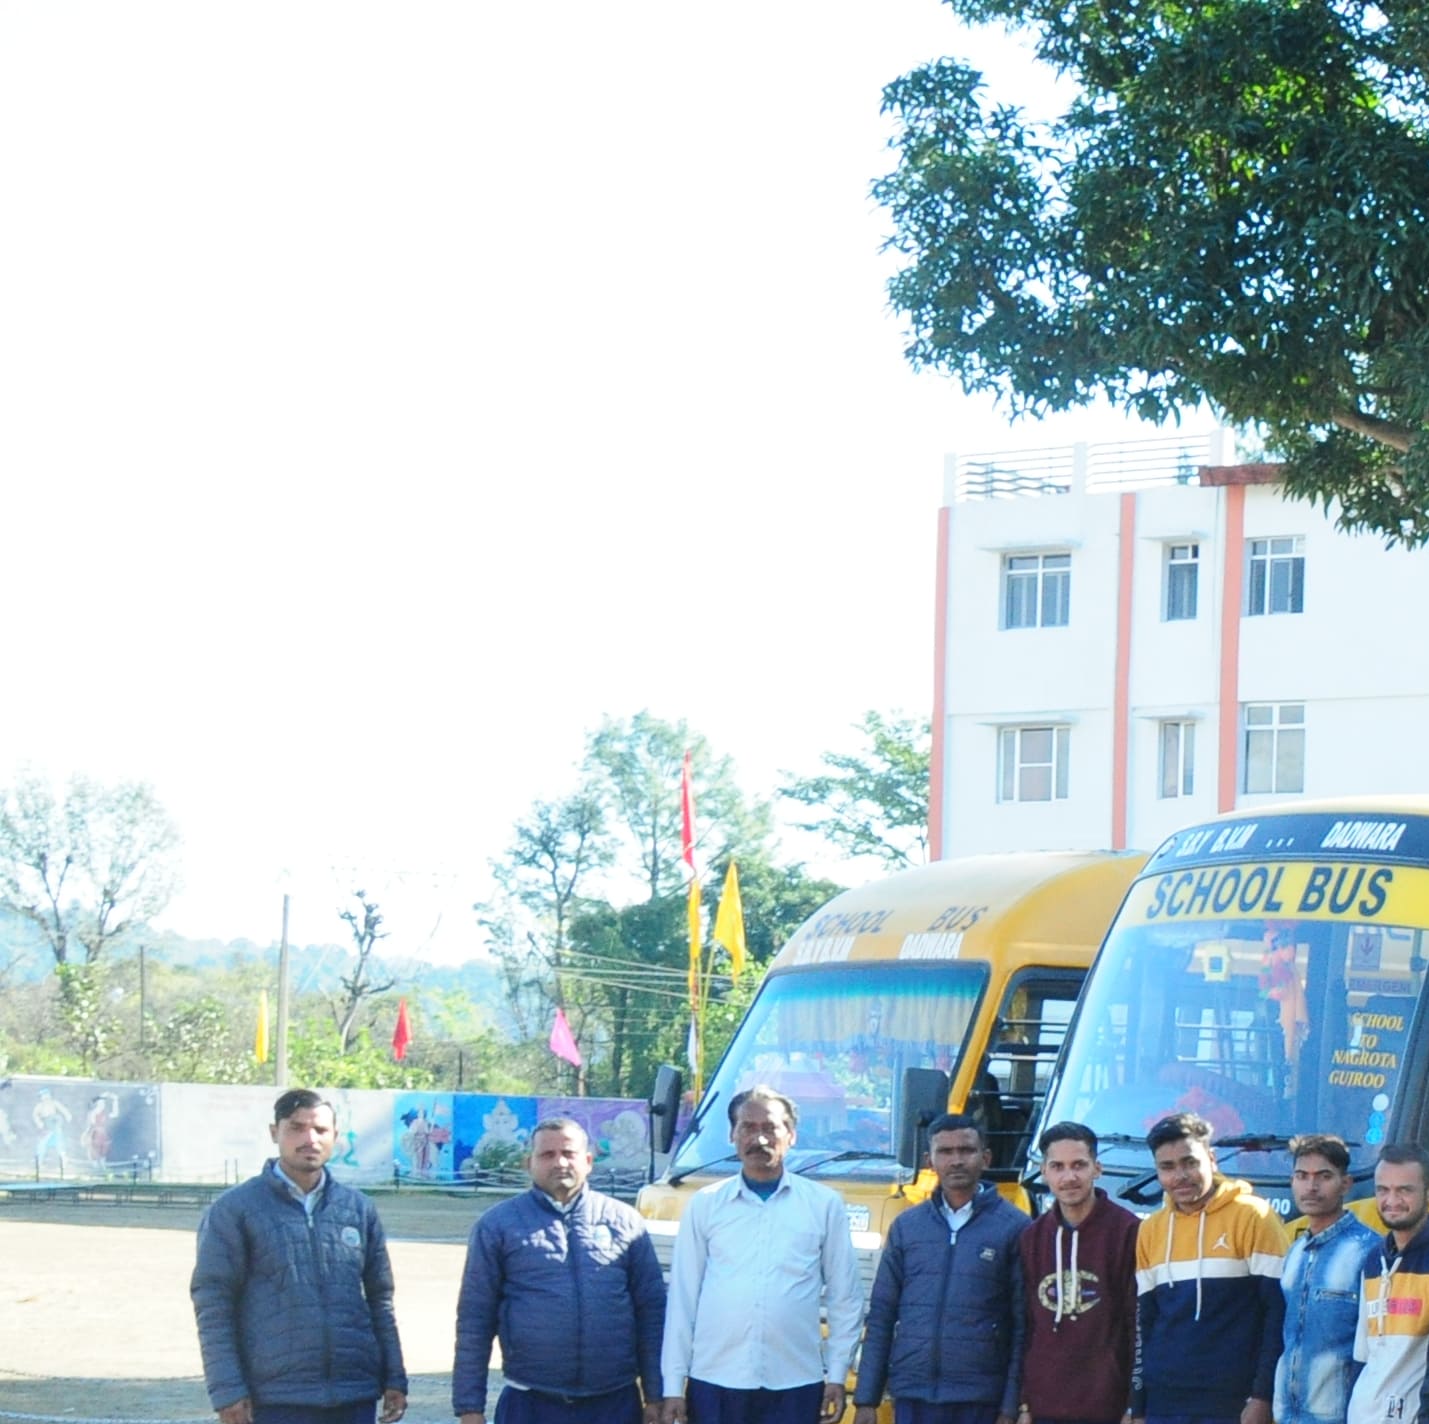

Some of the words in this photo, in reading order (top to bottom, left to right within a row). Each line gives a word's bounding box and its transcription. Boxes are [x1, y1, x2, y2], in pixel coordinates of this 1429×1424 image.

[1320, 820, 1407, 851] DADWARA
[1146, 866, 1285, 920] SCHOOL
[1297, 866, 1394, 918] BUS
[804, 909, 894, 940] SCHOOL
[927, 905, 988, 931] BUS
[1351, 1012, 1405, 1031] SCHOOL
[1359, 1034, 1379, 1049] TO
